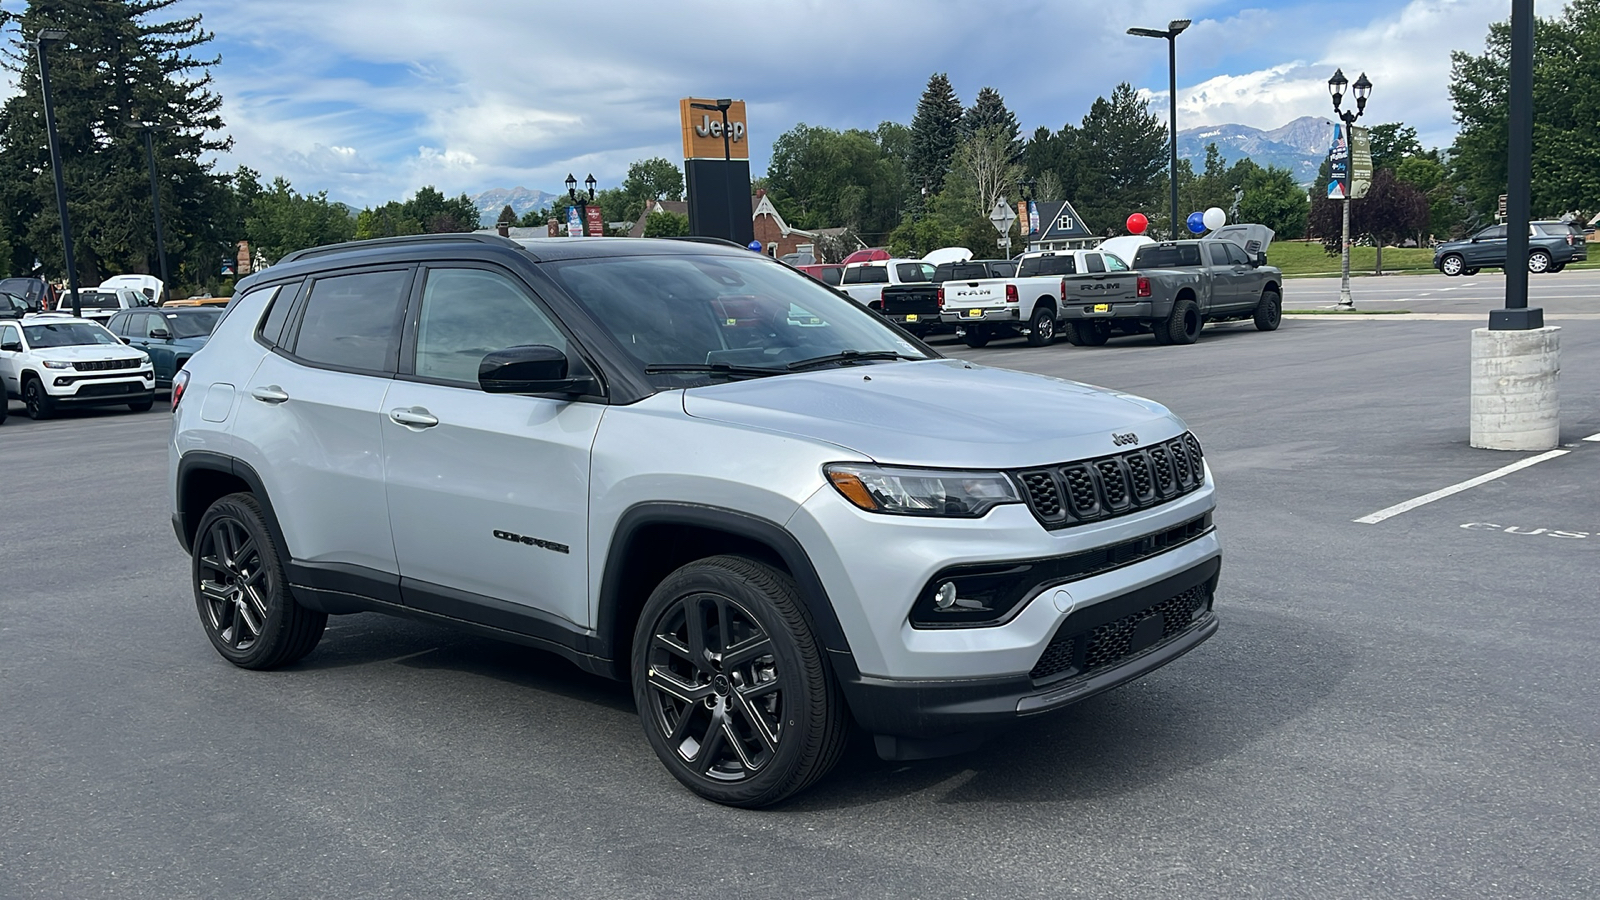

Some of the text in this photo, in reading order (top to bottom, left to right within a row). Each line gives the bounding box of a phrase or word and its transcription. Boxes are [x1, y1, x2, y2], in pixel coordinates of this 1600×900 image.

[696, 115, 745, 142] Jeep
[1112, 432, 1139, 446] Jeep
[1460, 522, 1600, 539] CUS
[493, 529, 570, 554] COMPASS
